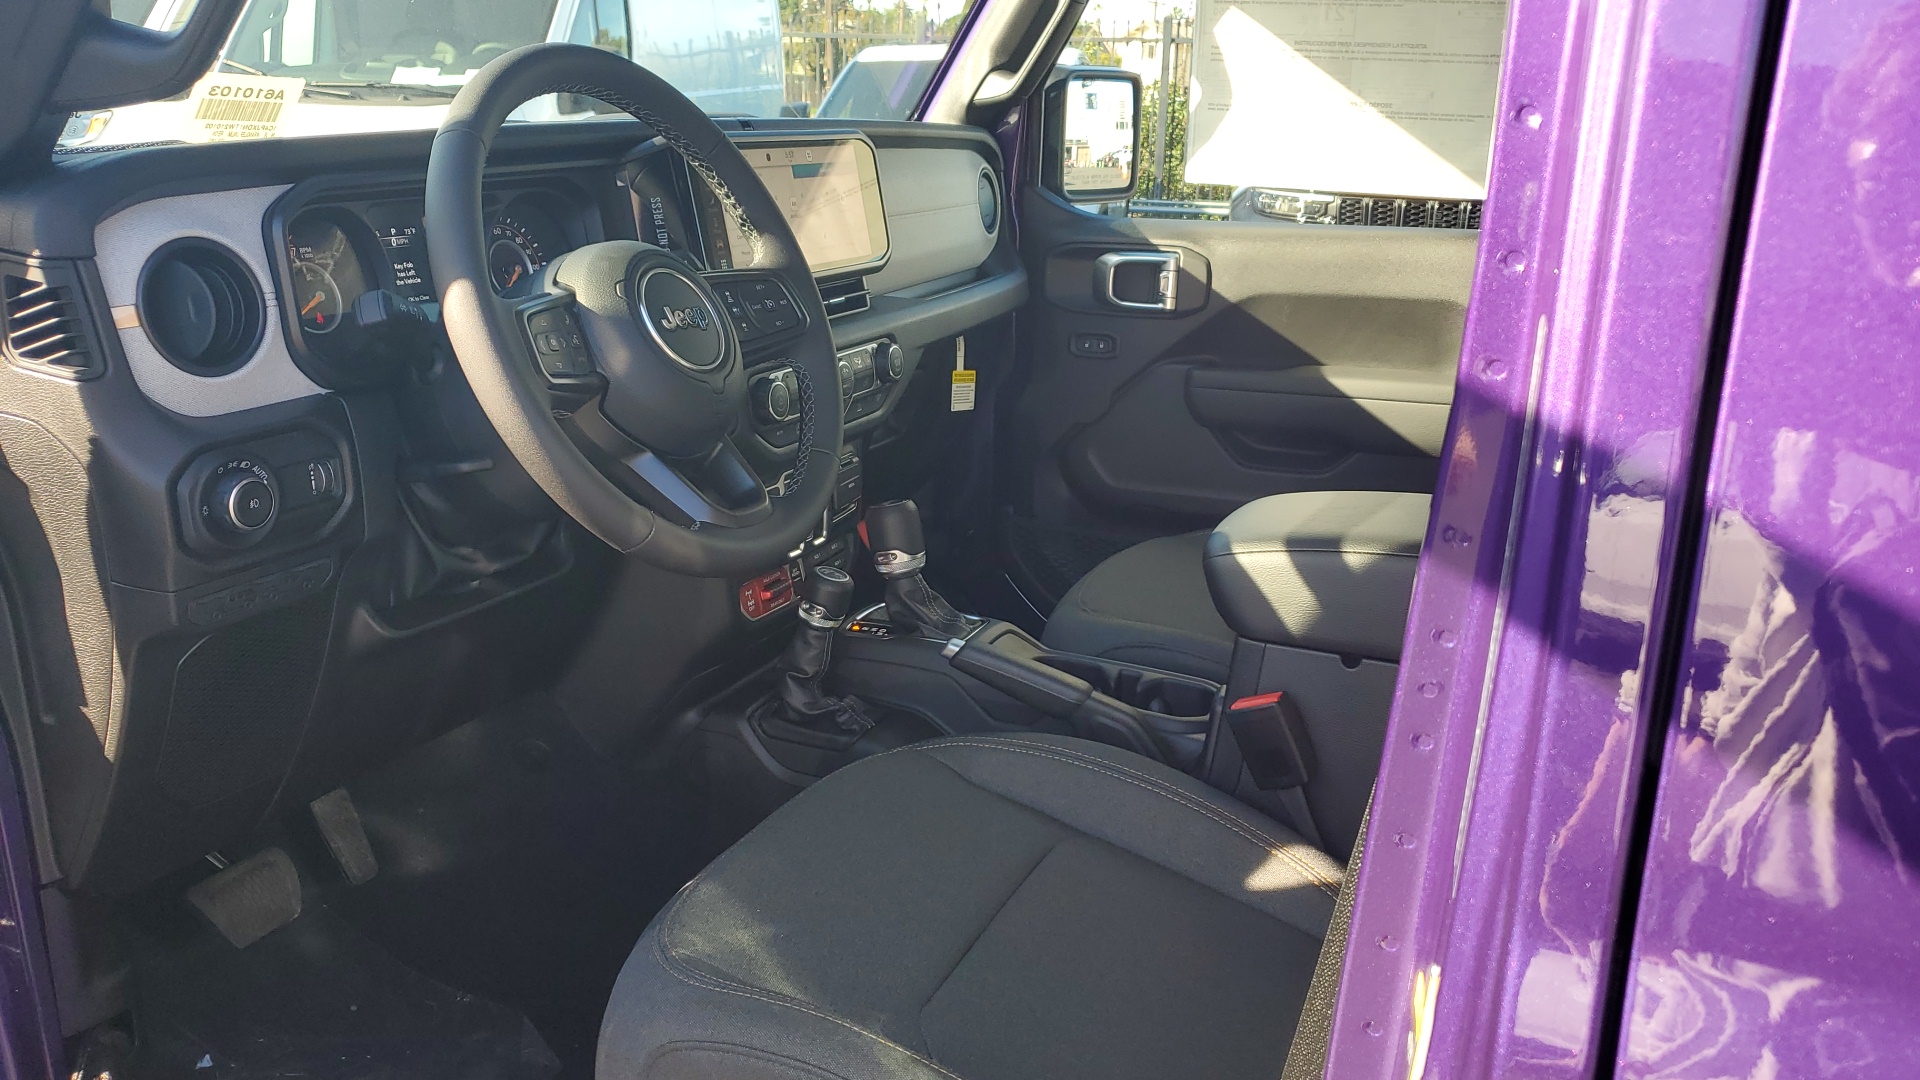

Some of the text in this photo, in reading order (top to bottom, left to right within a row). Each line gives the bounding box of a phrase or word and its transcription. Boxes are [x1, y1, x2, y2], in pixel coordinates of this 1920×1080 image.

[650, 197, 665, 225] PRESS
[656, 228, 669, 246] NOT
[405, 277, 421, 285] Vehicle
[660, 305, 709, 331] Jeep
[252, 465, 268, 480] AUTO
